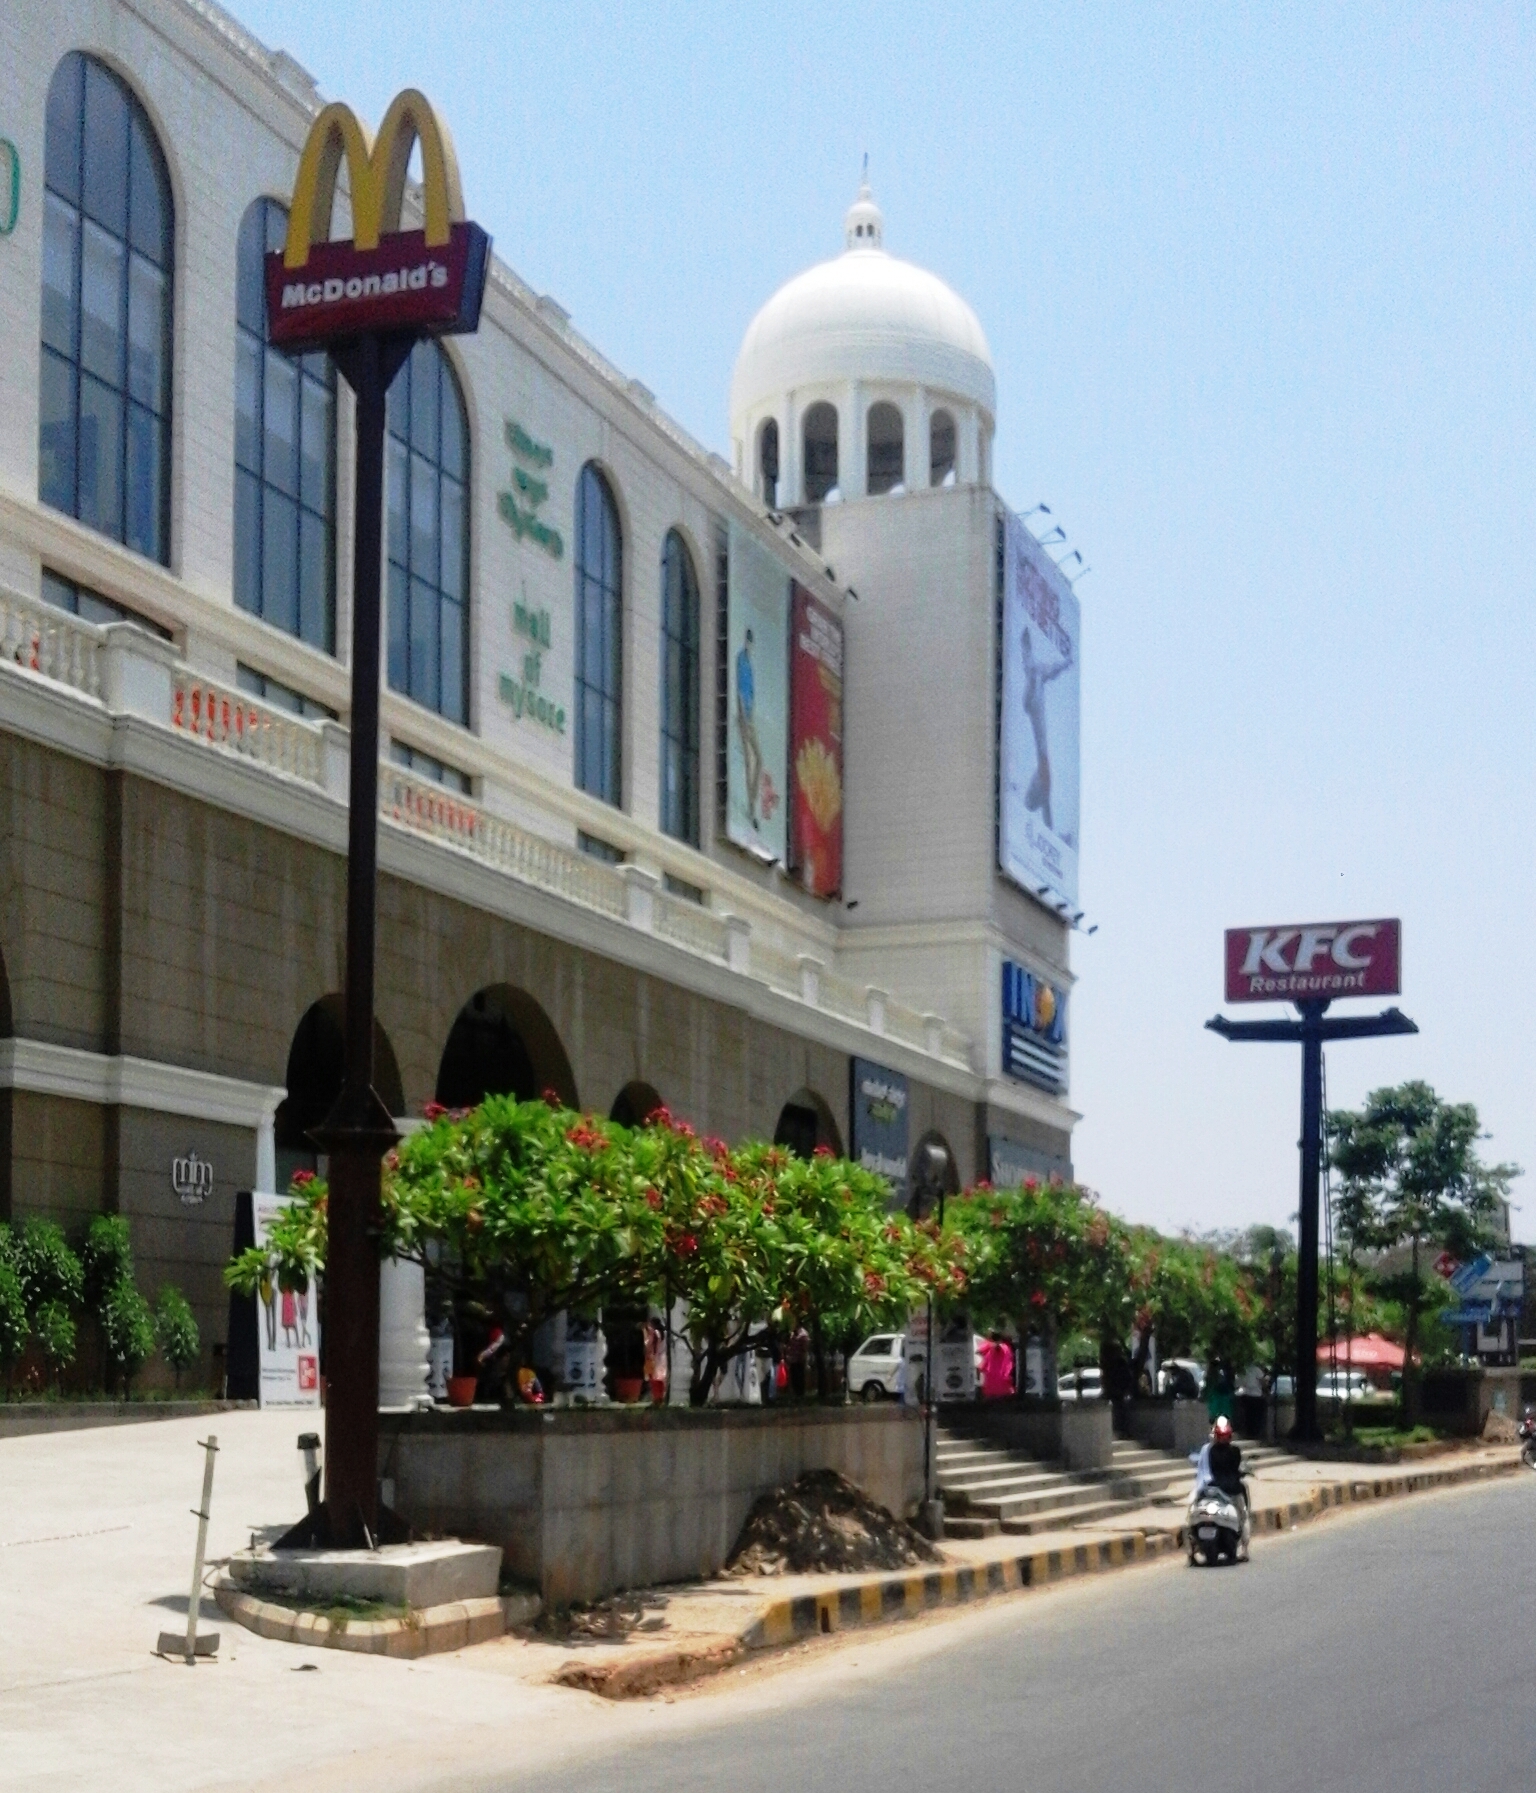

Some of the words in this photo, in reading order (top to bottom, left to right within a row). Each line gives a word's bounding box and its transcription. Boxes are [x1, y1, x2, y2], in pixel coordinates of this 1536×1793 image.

[281, 260, 449, 309] McDonald's
[1239, 924, 1377, 974] KFC
[1250, 970, 1365, 992] Restaurant
